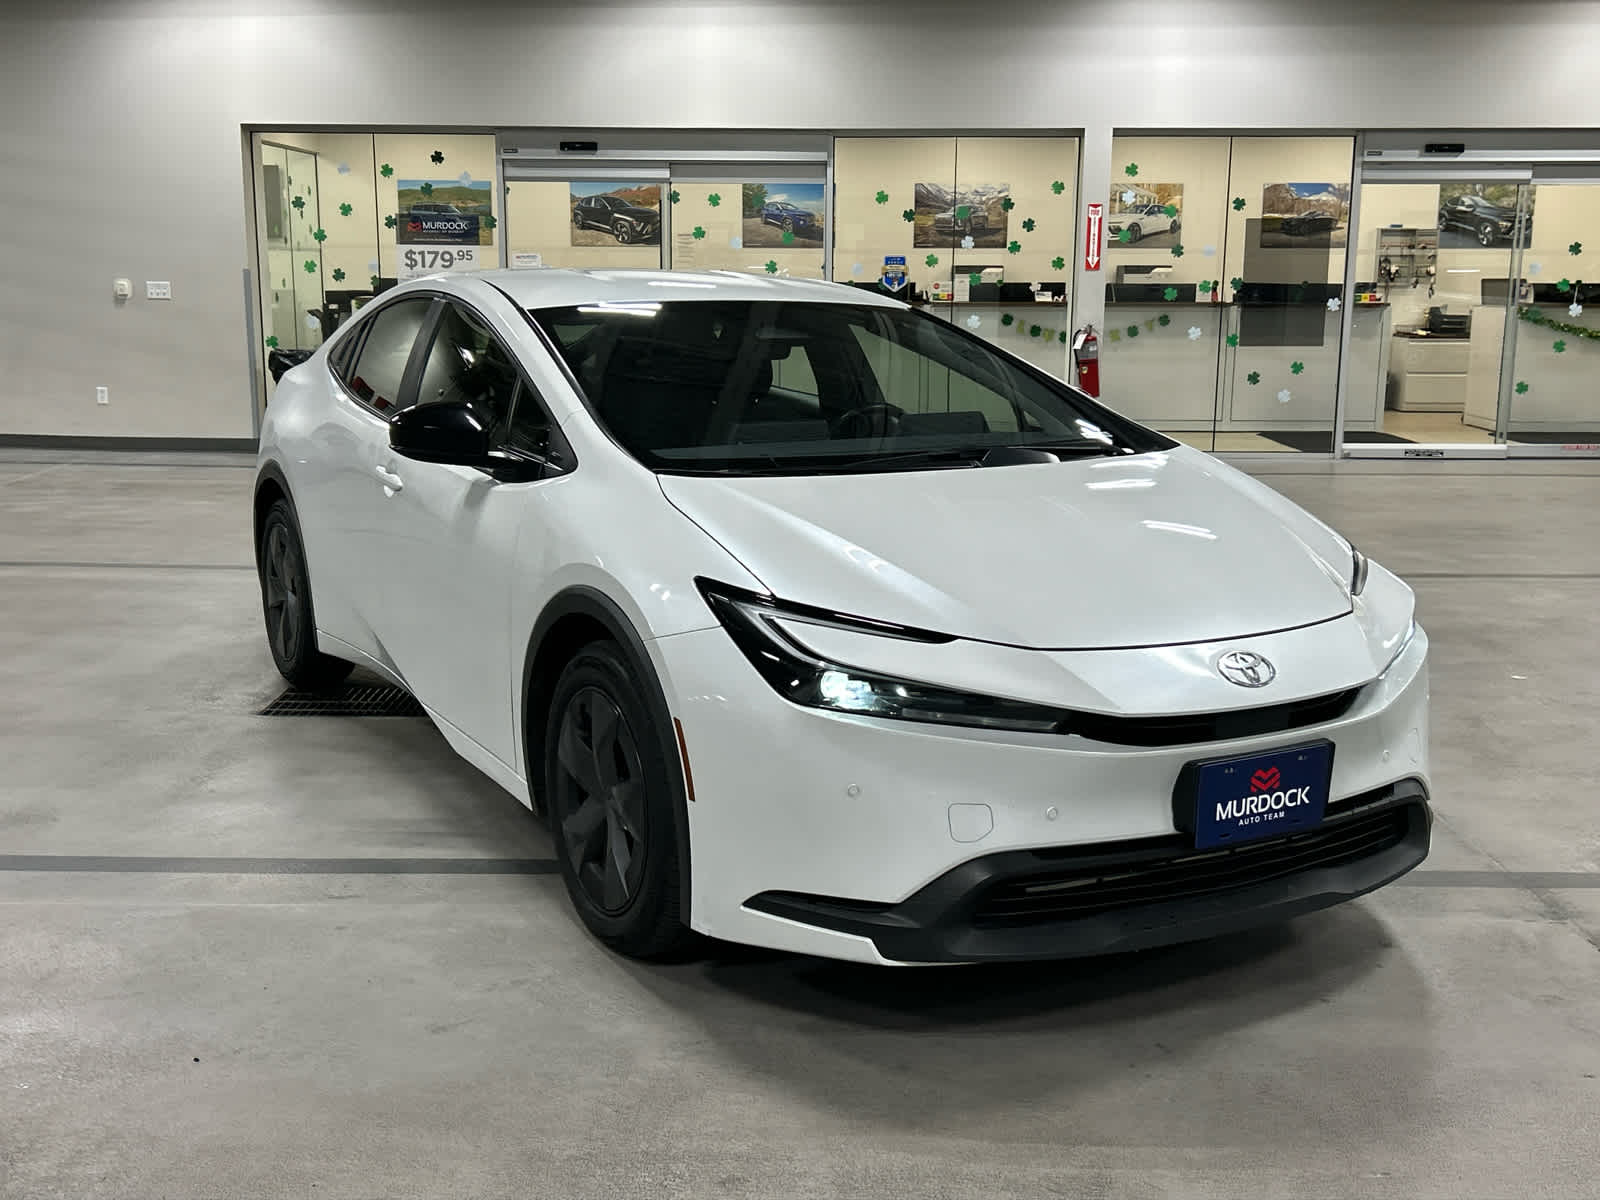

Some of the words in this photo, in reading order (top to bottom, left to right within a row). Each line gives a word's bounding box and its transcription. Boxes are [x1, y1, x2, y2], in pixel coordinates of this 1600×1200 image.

[422, 221, 468, 230] MURDOCK
[404, 249, 473, 270] $179.95
[1215, 785, 1310, 821] MURDOCK
[1239, 816, 1260, 826] AUTO
[1264, 811, 1285, 821] TEAM
